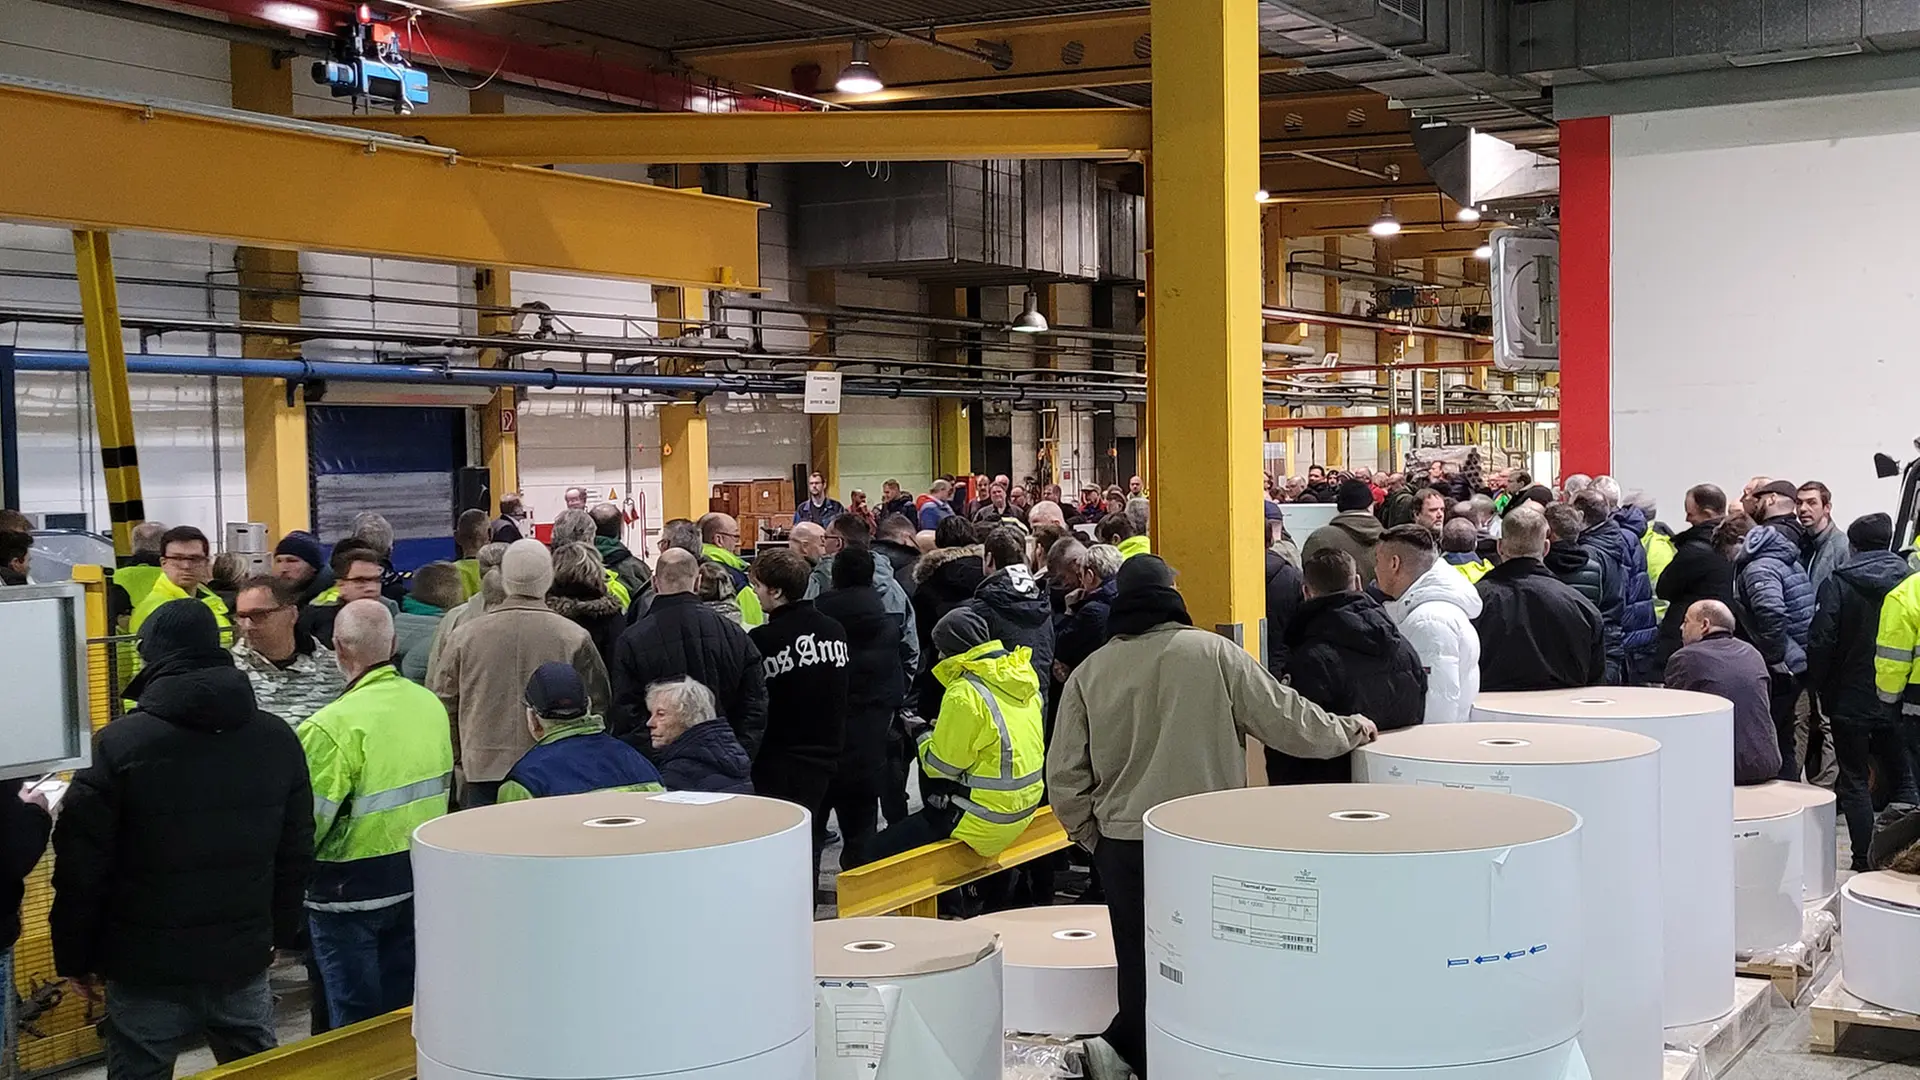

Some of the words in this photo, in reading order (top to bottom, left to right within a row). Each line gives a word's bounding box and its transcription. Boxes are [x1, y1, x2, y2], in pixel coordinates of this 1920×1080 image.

[763, 645, 795, 680] os
[1240, 882, 1260, 891] Thermal
[1261, 885, 1277, 893] Paper
